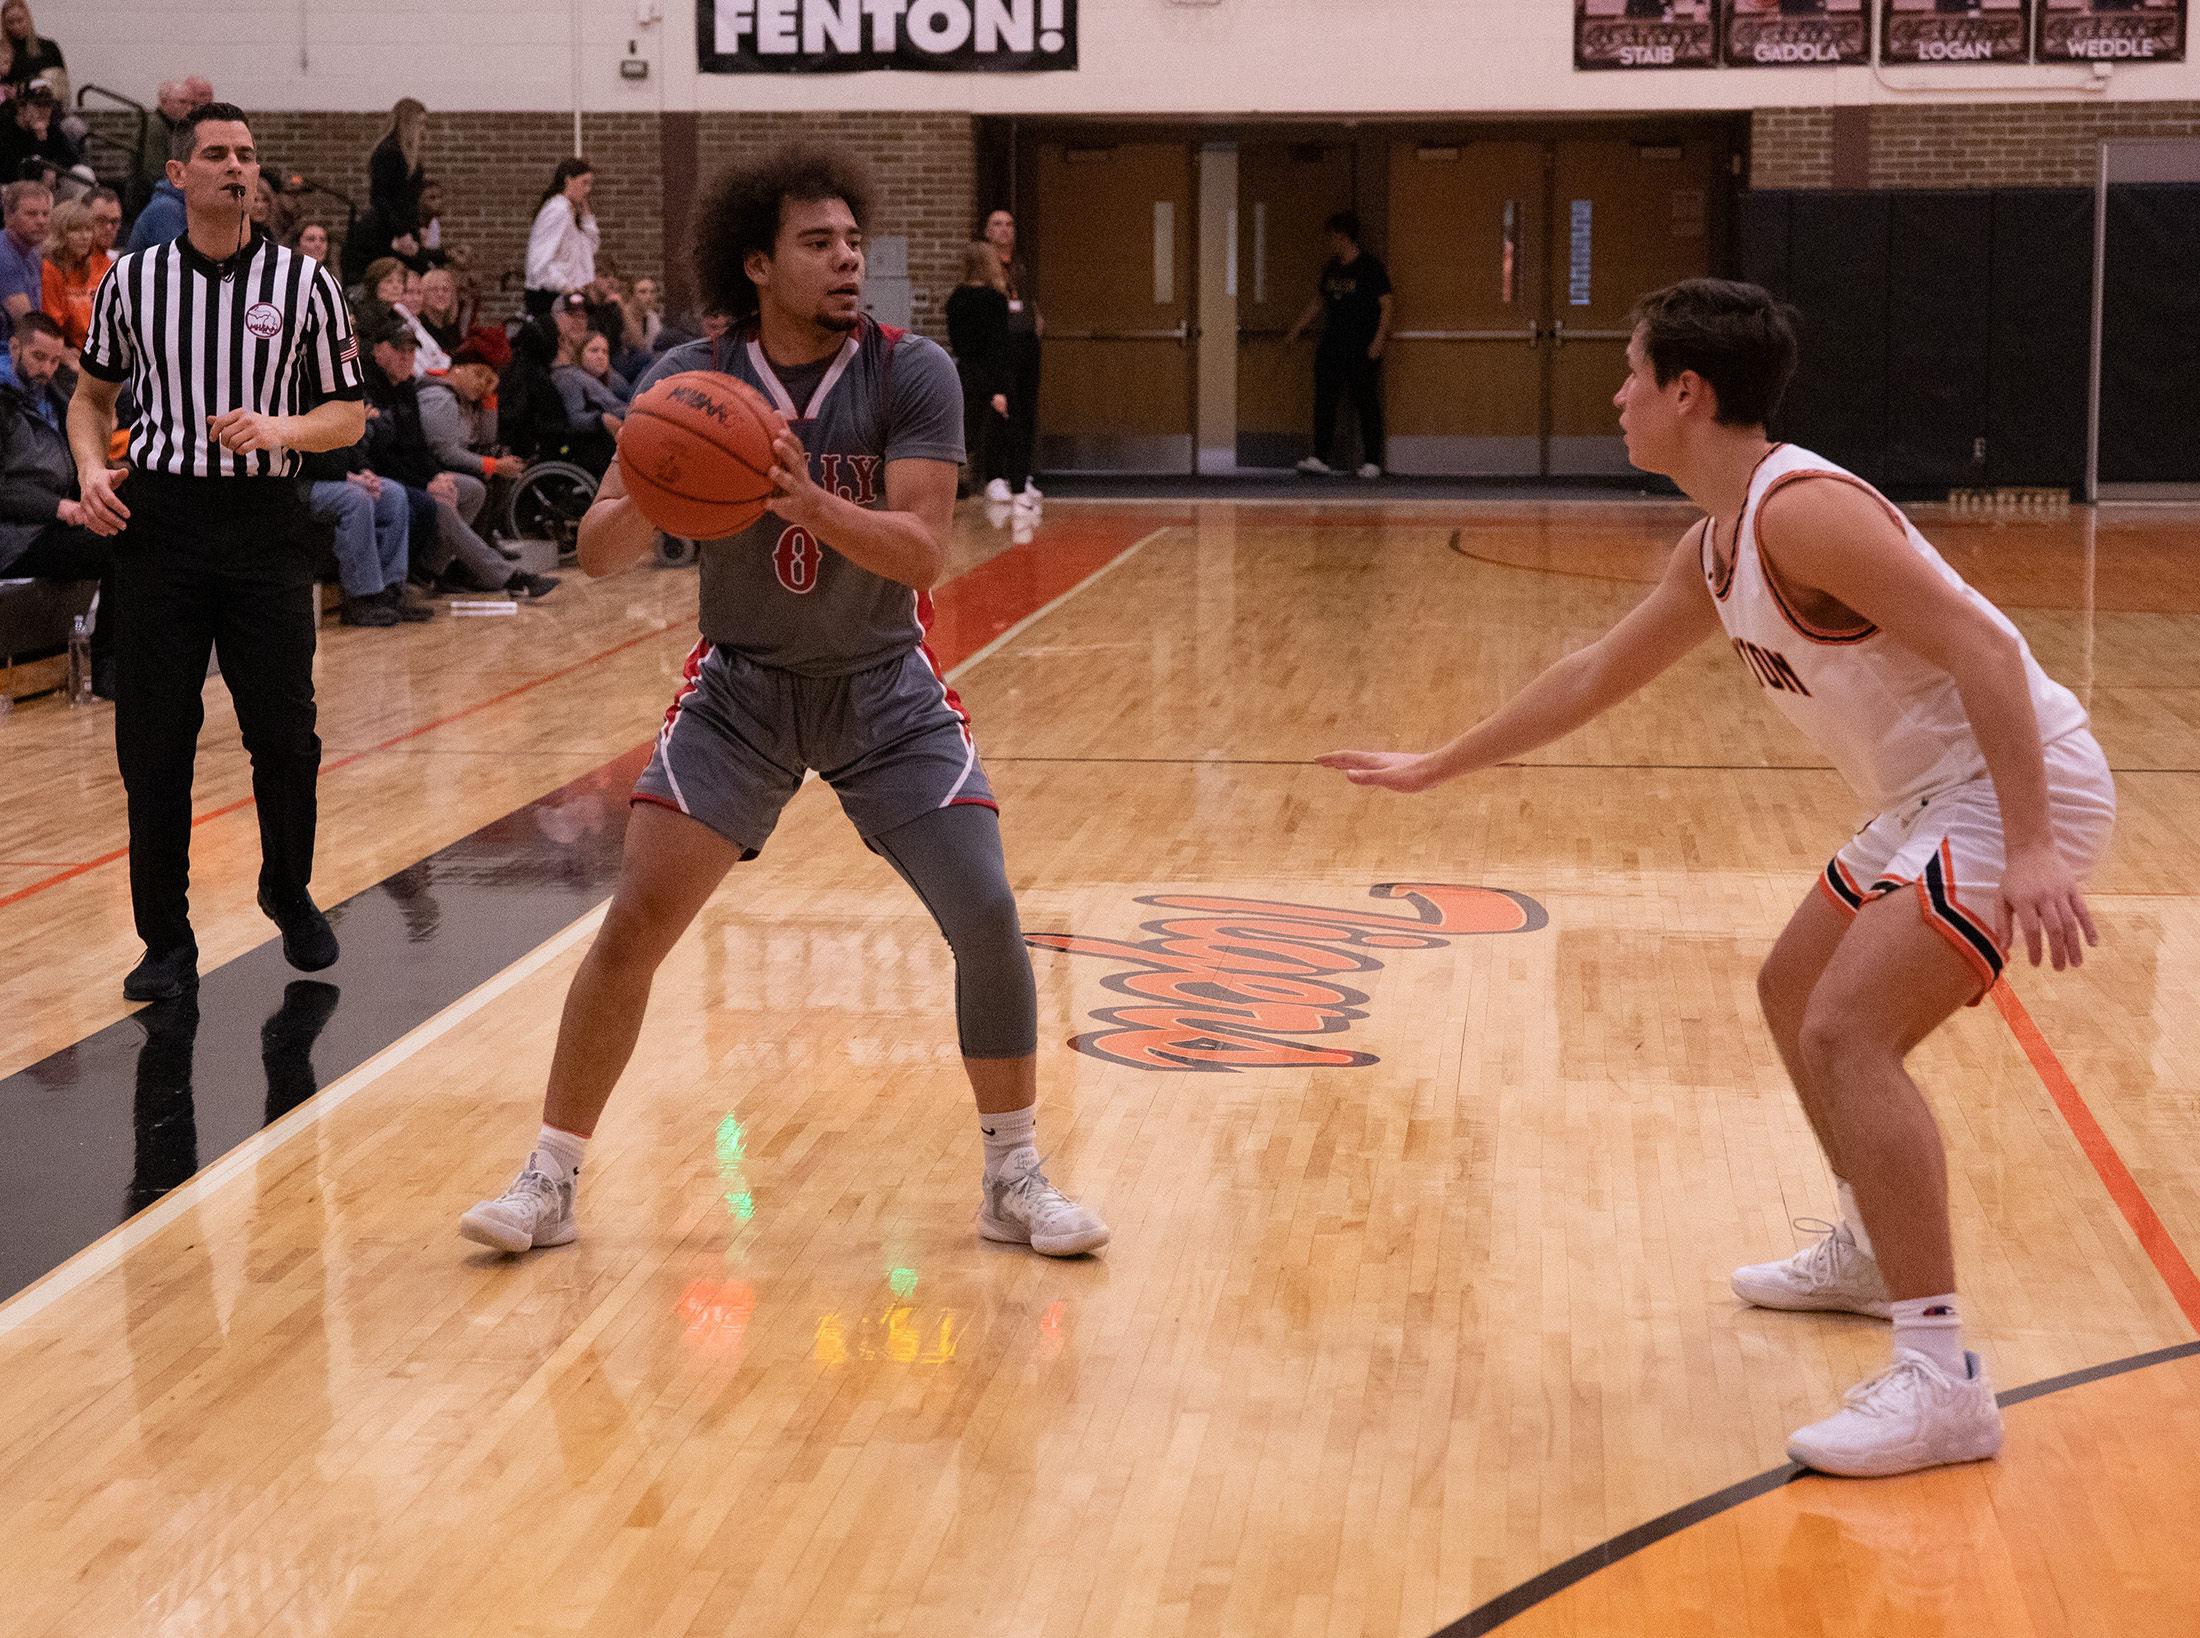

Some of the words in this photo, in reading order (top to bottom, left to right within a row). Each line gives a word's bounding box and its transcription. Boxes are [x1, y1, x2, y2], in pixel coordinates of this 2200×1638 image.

[714, 0, 1065, 54] FENTON!
[1754, 43, 1840, 62] GADOLA
[1918, 41, 1992, 60] LOGAN
[2066, 38, 2154, 57] WEDDLE
